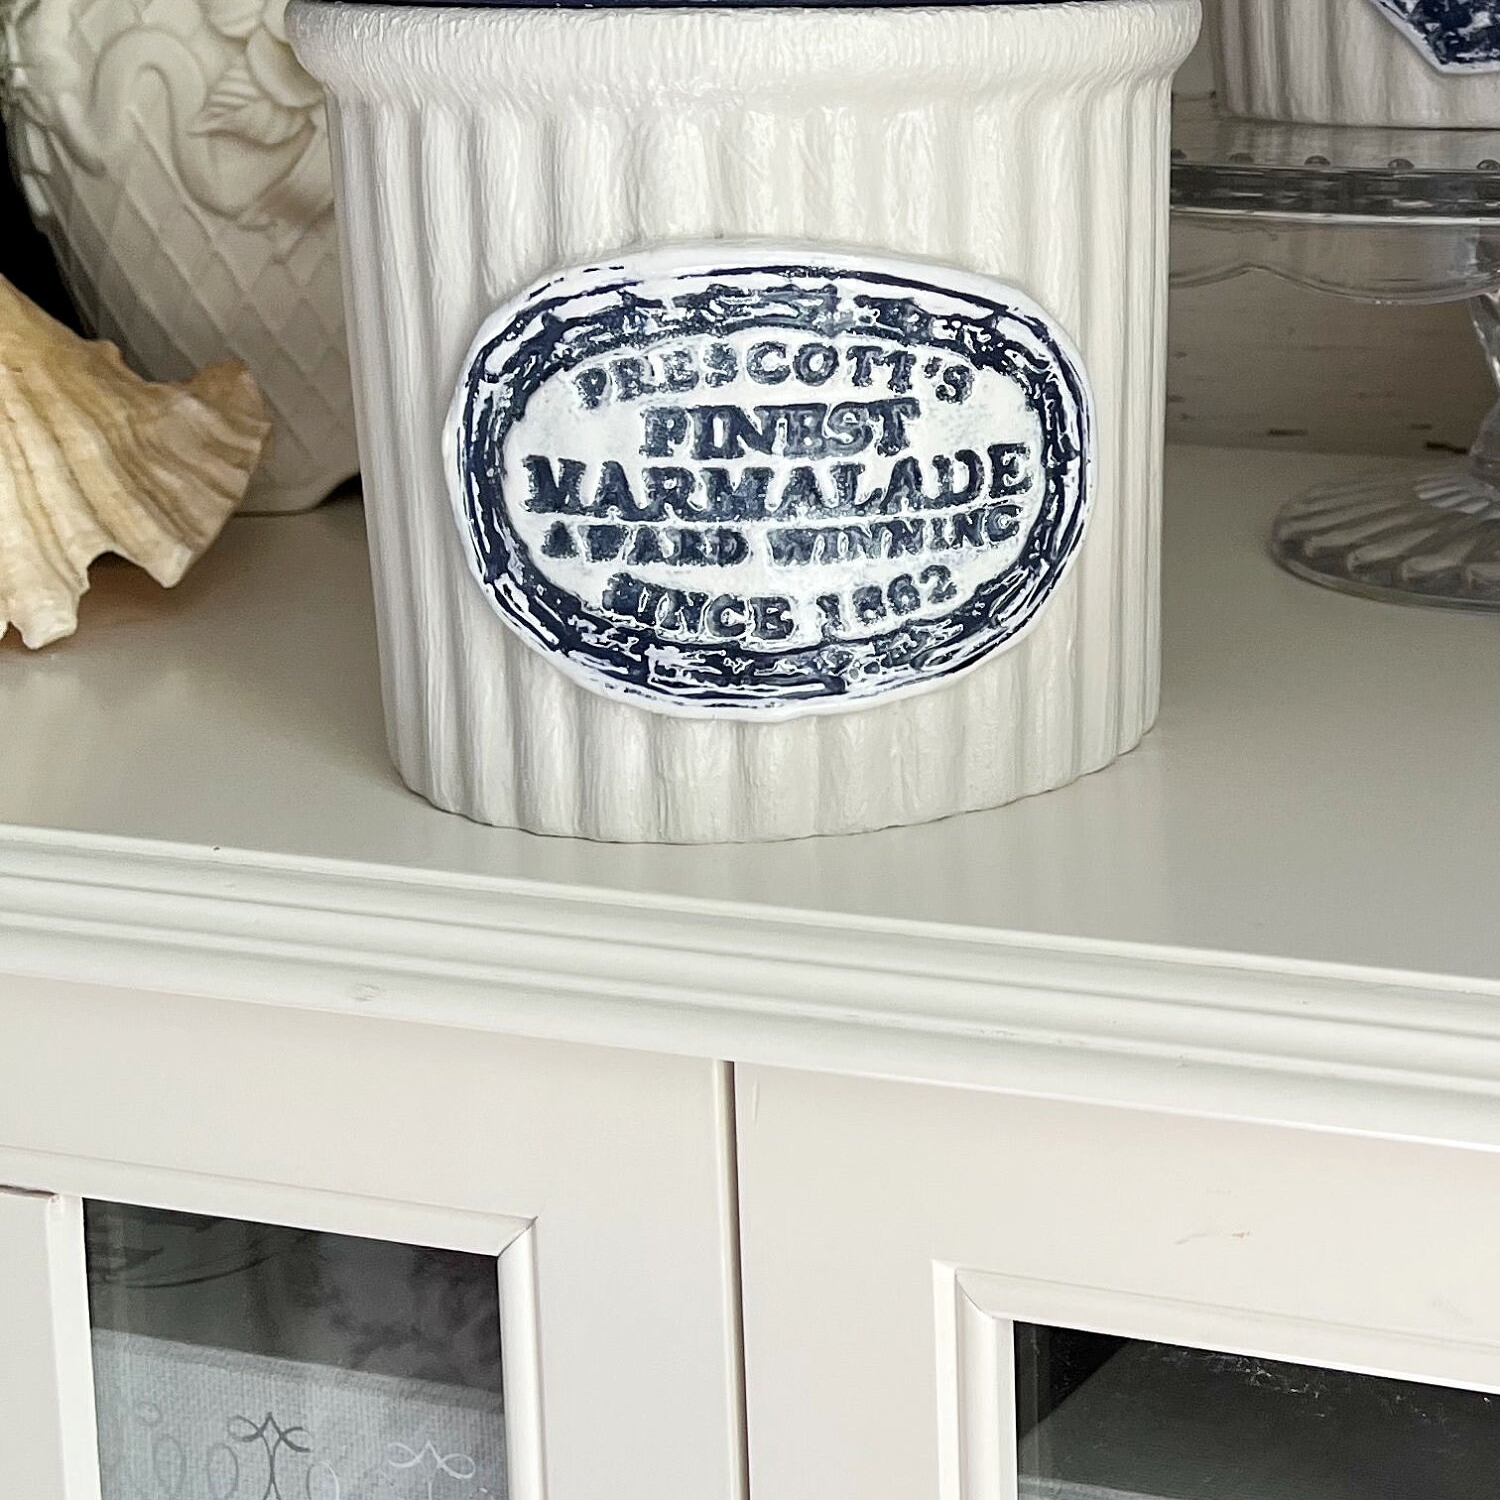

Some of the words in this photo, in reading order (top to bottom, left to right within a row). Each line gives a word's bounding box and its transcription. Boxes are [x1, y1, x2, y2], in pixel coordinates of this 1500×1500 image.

[574, 340, 977, 409] PRESCOTT'S
[640, 397, 921, 460] FINEST
[522, 442, 1033, 522] MARMALADE
[540, 521, 752, 567] AWARD
[767, 503, 1024, 568] WINNING
